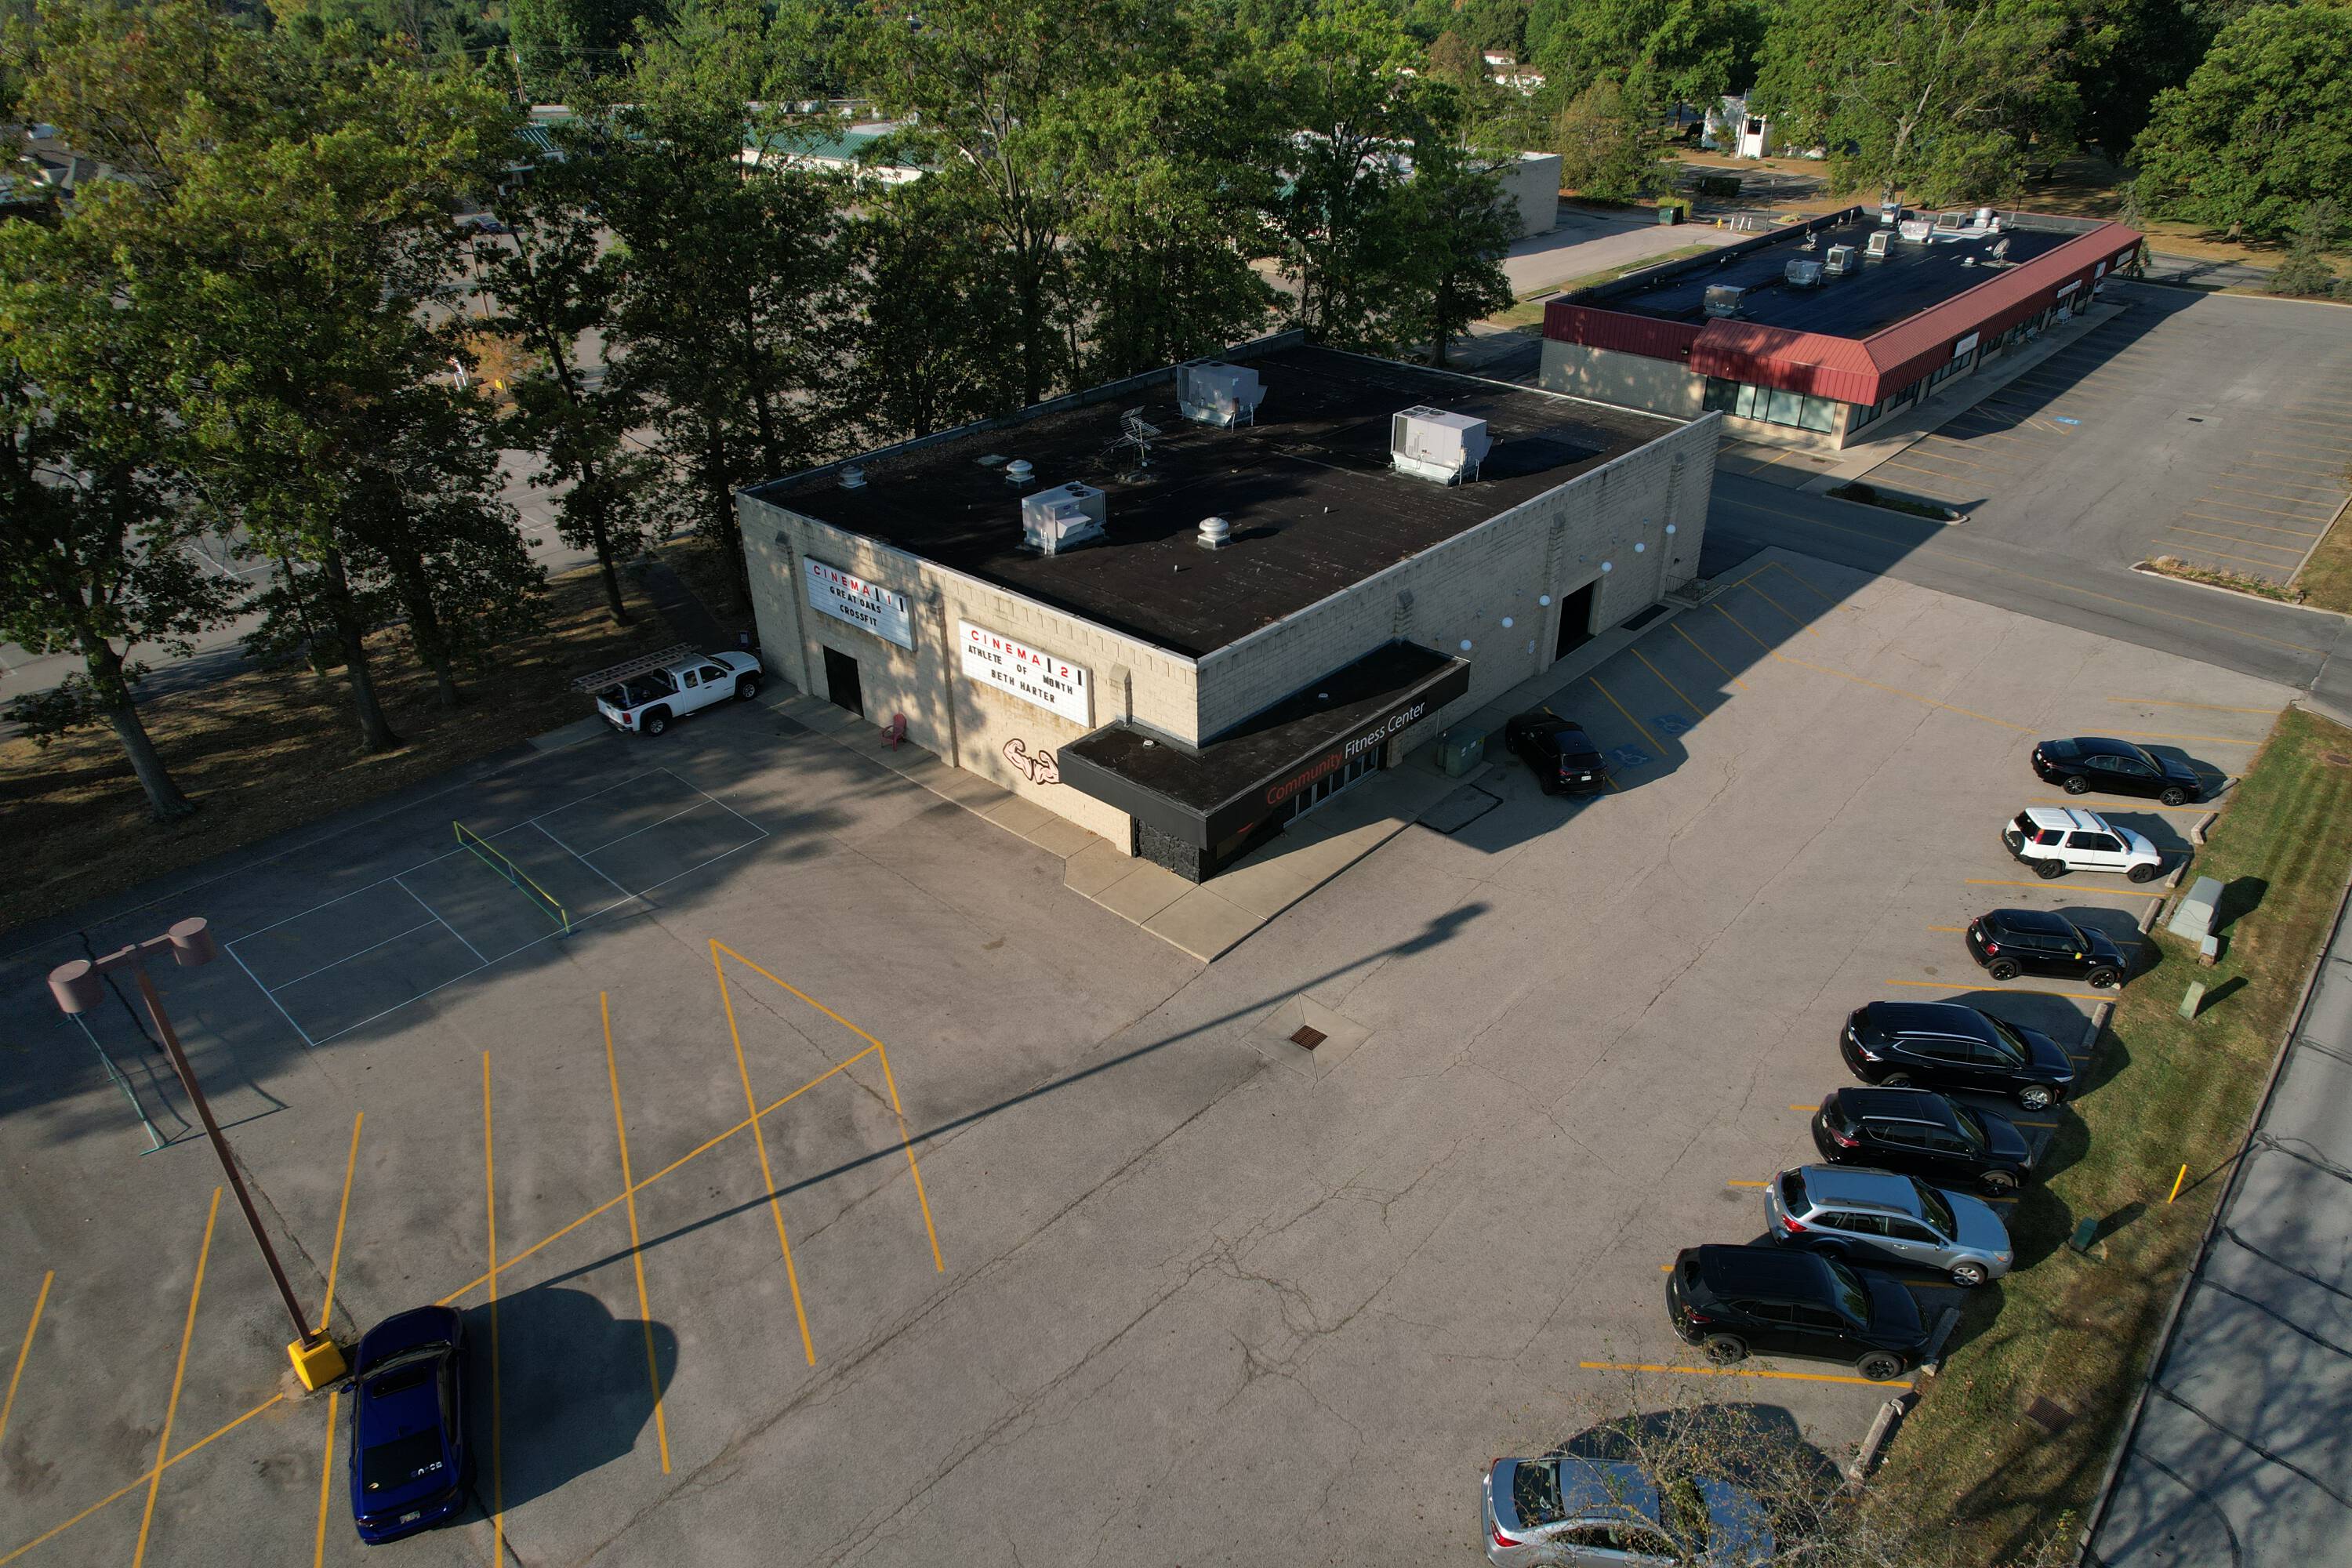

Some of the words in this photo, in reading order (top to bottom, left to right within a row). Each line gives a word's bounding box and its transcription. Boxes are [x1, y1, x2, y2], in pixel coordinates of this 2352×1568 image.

[814, 565, 870, 596] CINEMA
[829, 586, 857, 604] GREAT
[860, 599, 881, 614] OAKS
[840, 604, 877, 626] CROSSFIT
[968, 644, 1002, 665] ATHLETE
[1016, 664, 1027, 675] OF
[1043, 674, 1073, 695] MONTH
[971, 630, 1040, 666] CINEMA
[1060, 666, 1069, 678] 2
[991, 669, 1014, 686] BETH
[1020, 681, 1055, 703] HARTER
[1266, 751, 1343, 805] Community
[1345, 724, 1385, 760] Fitness
[1388, 701, 1425, 732] Center
